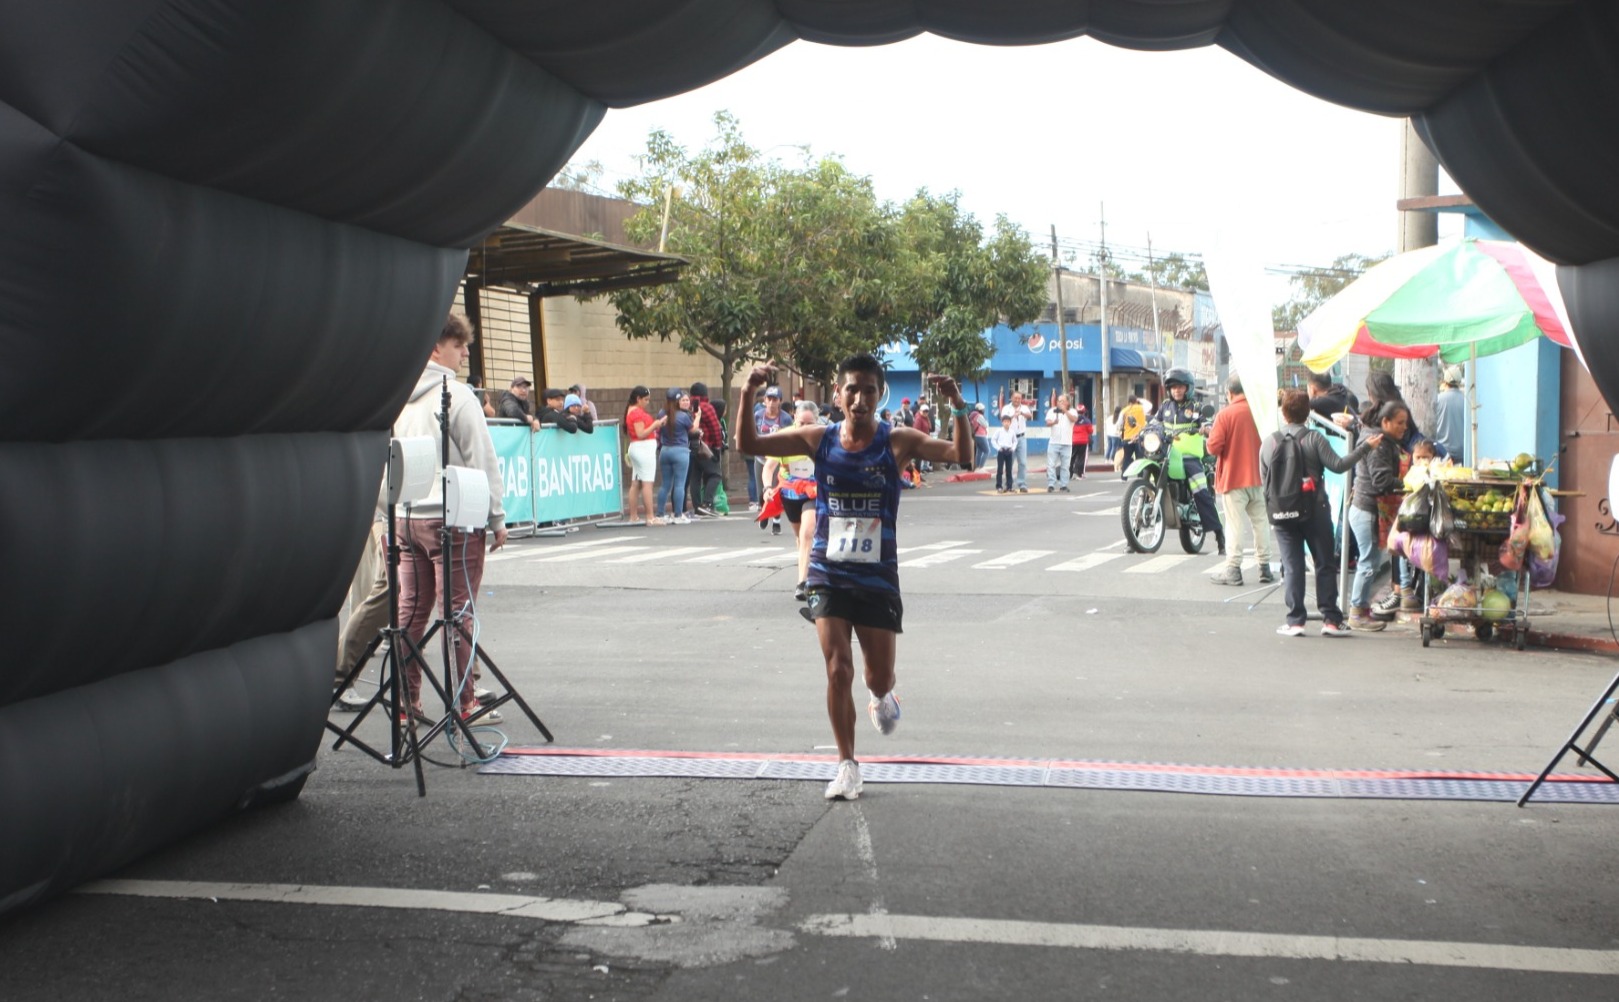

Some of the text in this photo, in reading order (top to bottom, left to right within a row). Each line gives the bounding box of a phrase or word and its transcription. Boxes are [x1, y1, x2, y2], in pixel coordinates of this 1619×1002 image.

[538, 453, 614, 498] BANTRAB
[828, 497, 880, 511] BLUE
[1272, 511, 1300, 520] adidas
[839, 538, 873, 553] 118
